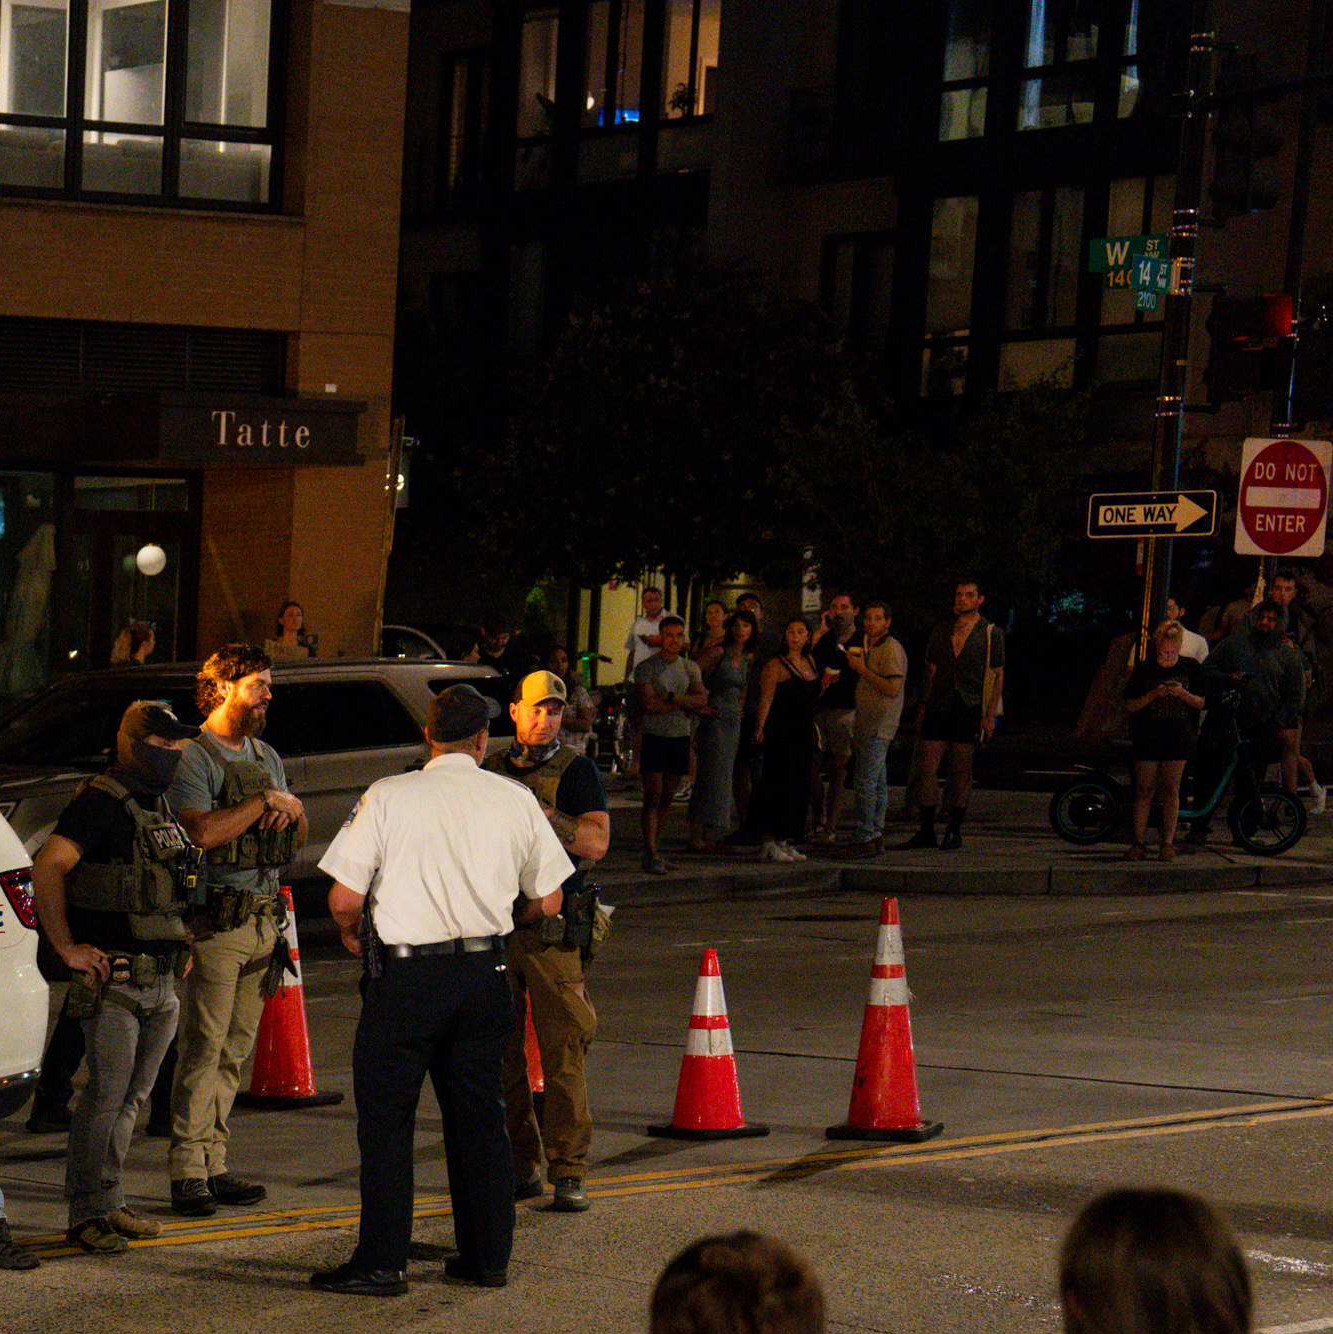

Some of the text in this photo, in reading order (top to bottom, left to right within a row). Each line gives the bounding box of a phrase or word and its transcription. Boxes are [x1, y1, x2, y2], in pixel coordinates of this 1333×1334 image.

[1105, 239, 1160, 267] W ST
[1138, 260, 1152, 286] 14
[1136, 291, 1157, 309] 2100
[211, 410, 311, 448] Tatte
[1254, 461, 1317, 482] DO NOT
[1103, 506, 1177, 524] ONE WAY
[1255, 513, 1306, 533] ENTER
